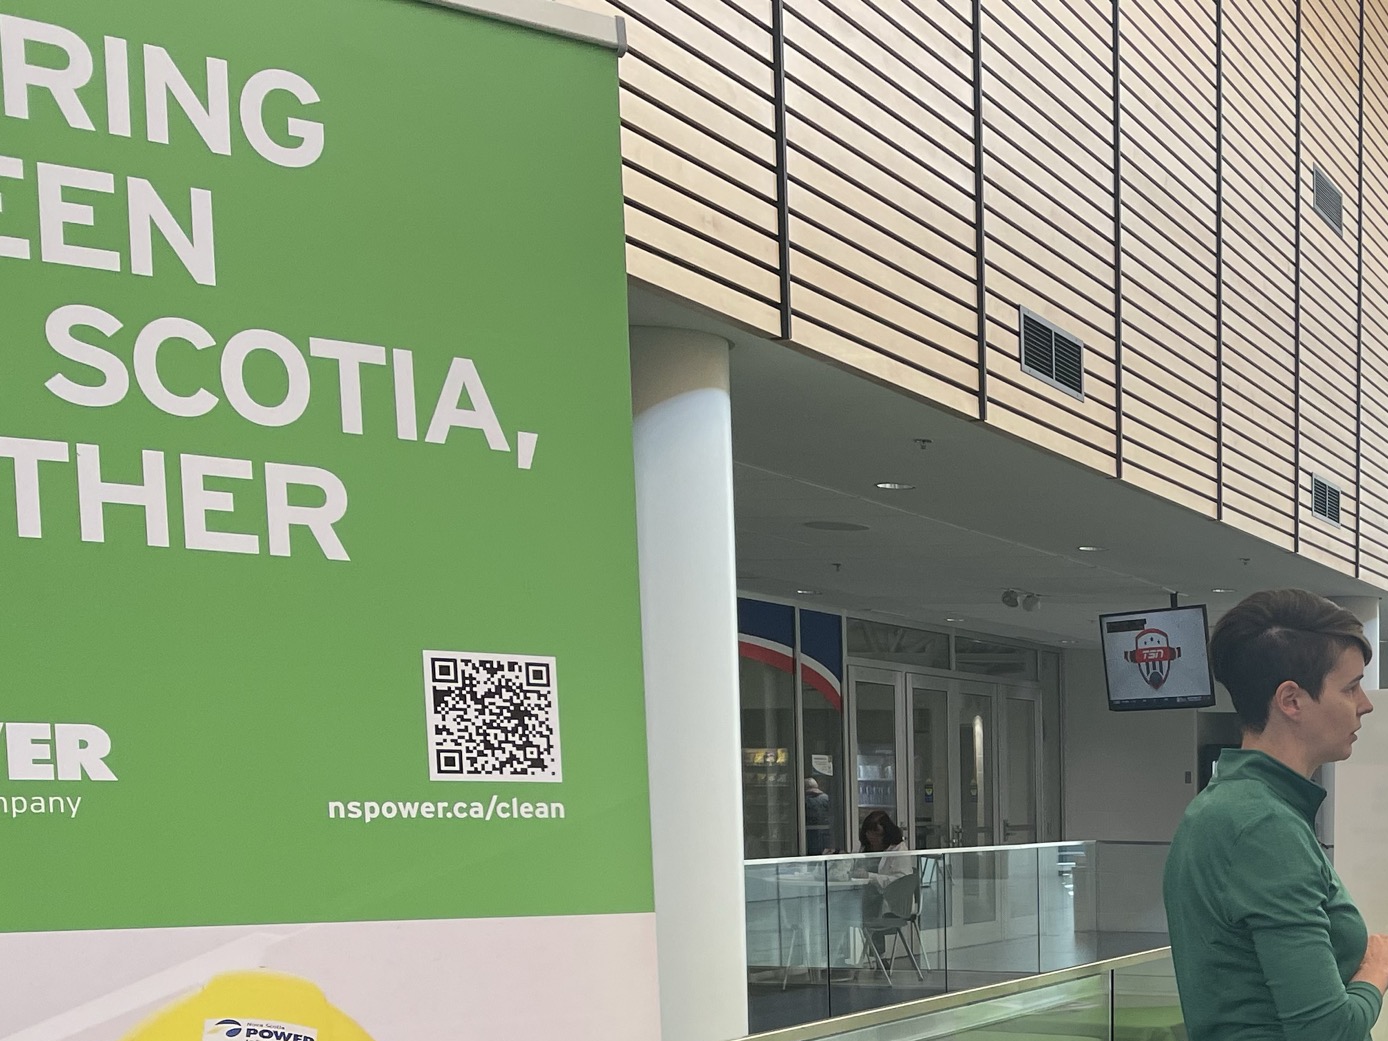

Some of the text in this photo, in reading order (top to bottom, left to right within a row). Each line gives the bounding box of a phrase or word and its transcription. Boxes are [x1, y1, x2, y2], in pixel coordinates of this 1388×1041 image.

[44, 303, 539, 470] SCOTIA,
[1142, 649, 1164, 660] TSN
[0, 722, 119, 781] ER
[328, 795, 566, 823] nspower.ca/clean
